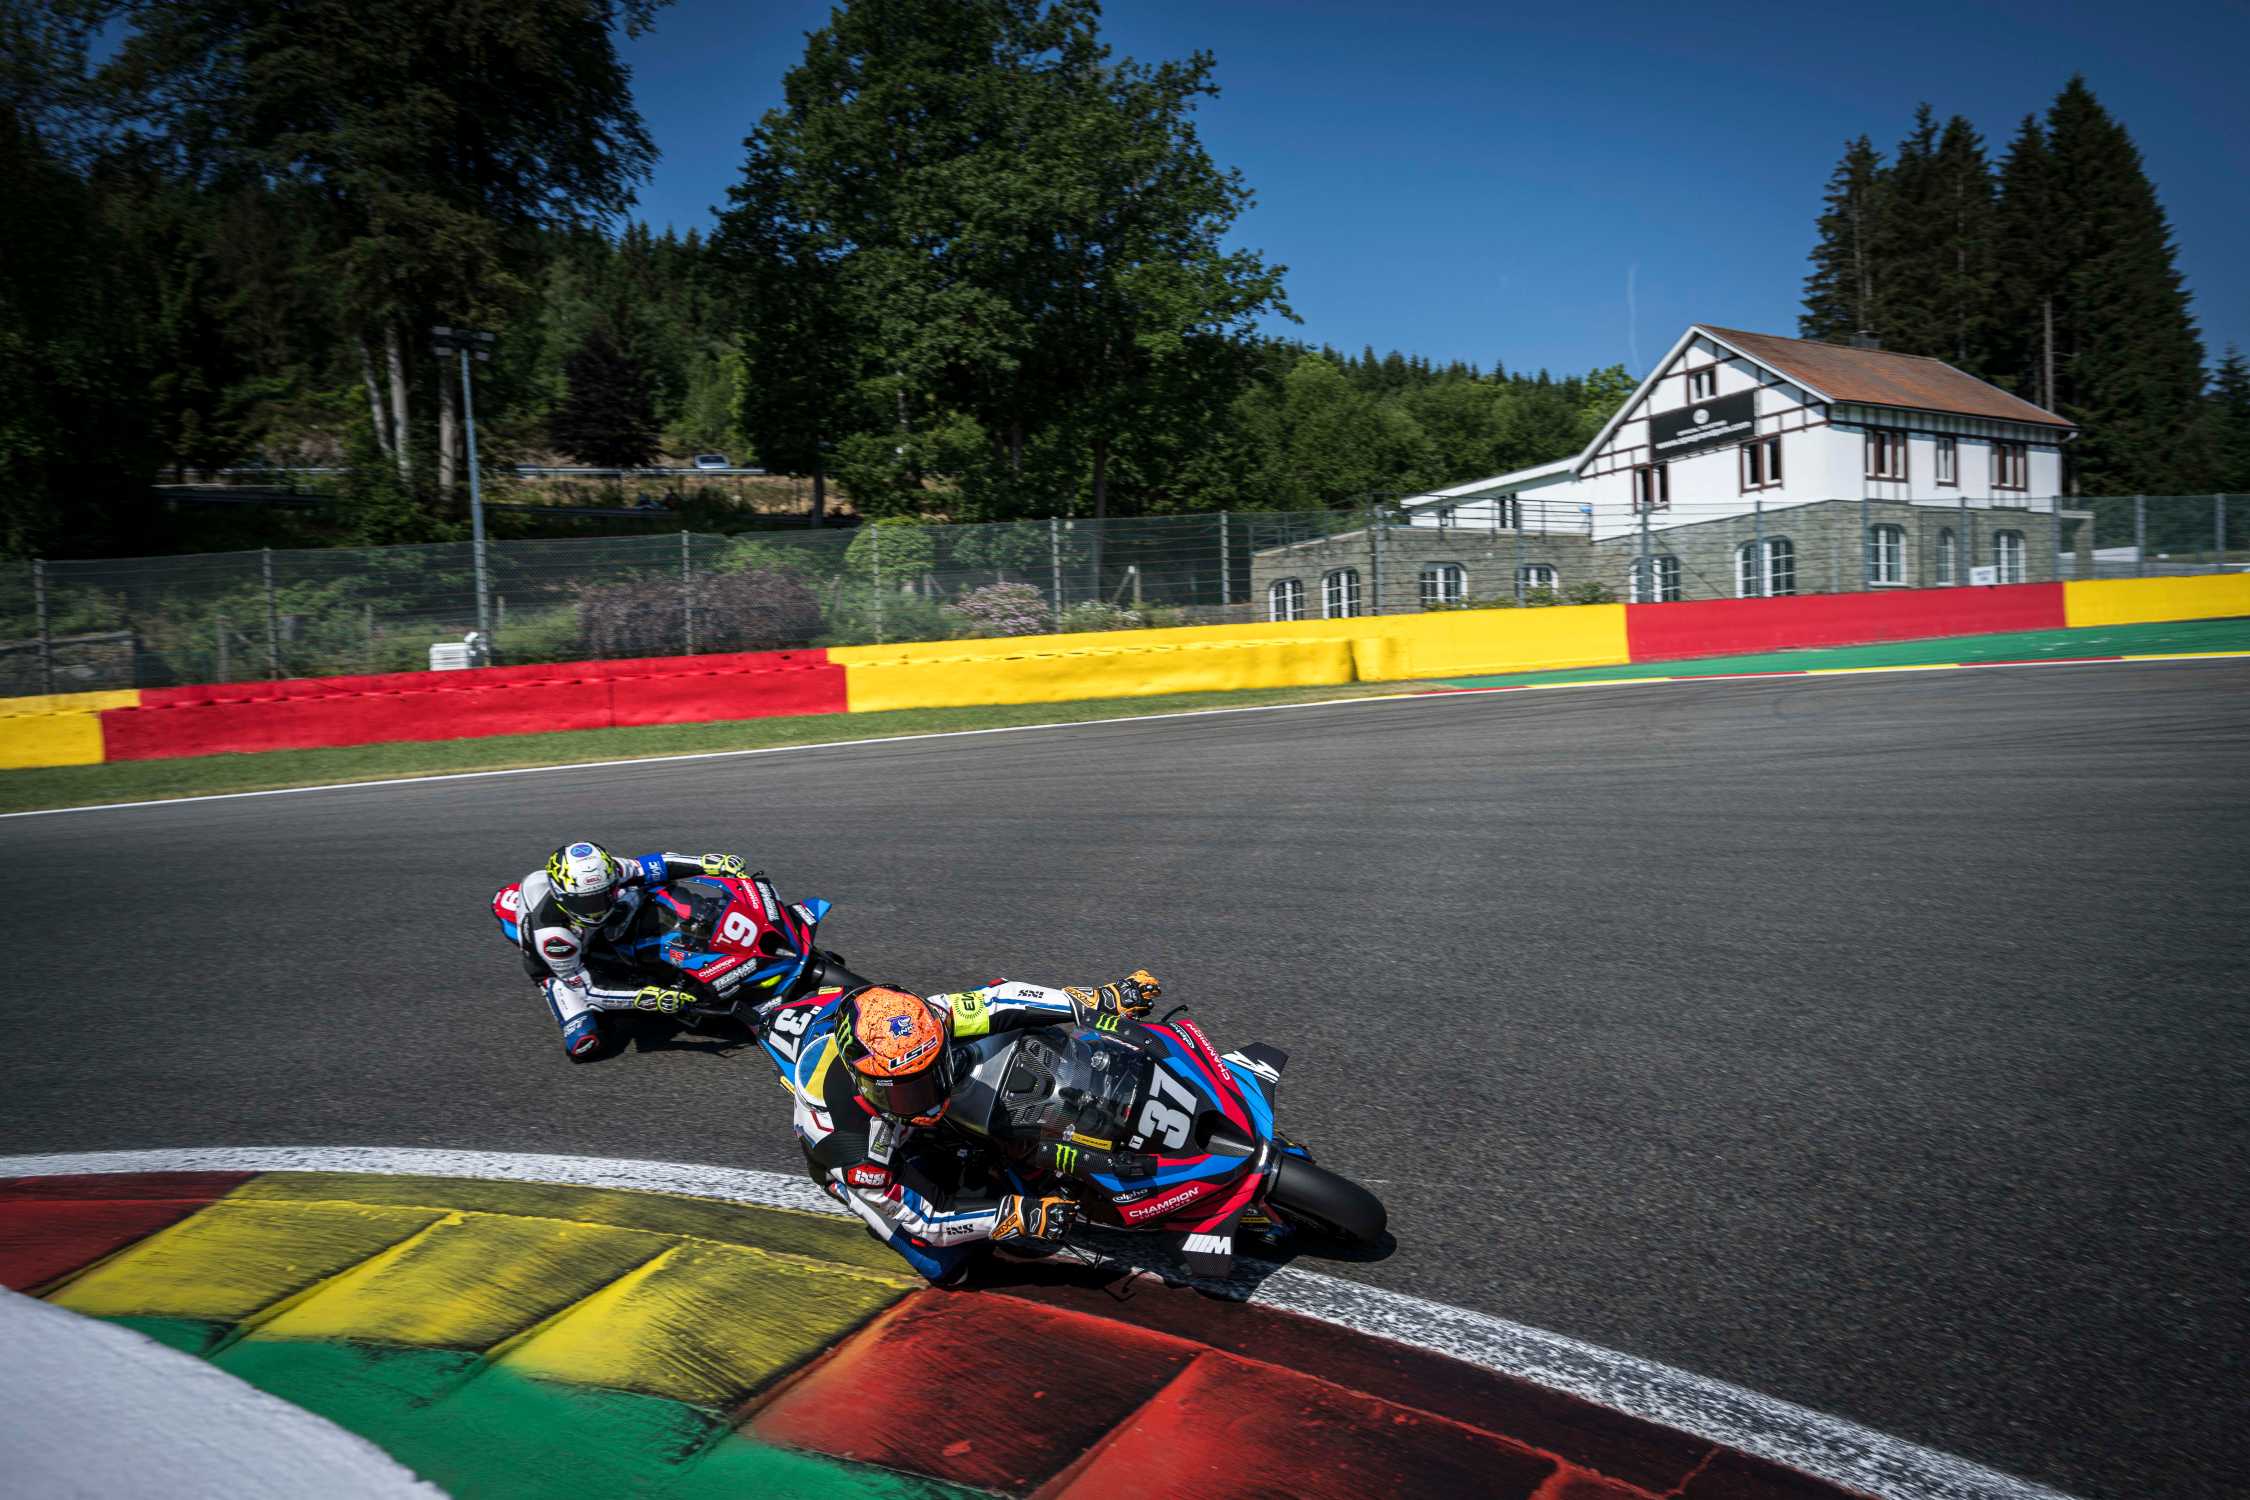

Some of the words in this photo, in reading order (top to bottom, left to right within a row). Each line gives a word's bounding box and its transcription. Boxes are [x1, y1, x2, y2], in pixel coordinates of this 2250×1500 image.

[723, 911, 758, 948] 9
[768, 1008, 813, 1064] 37
[888, 1035, 938, 1072] LS2
[1186, 1023, 1231, 1081] CHAMPION
[1137, 1063, 1198, 1149] 37
[1116, 1188, 1149, 1202] alpha
[1129, 1186, 1200, 1218] CHAMPION
